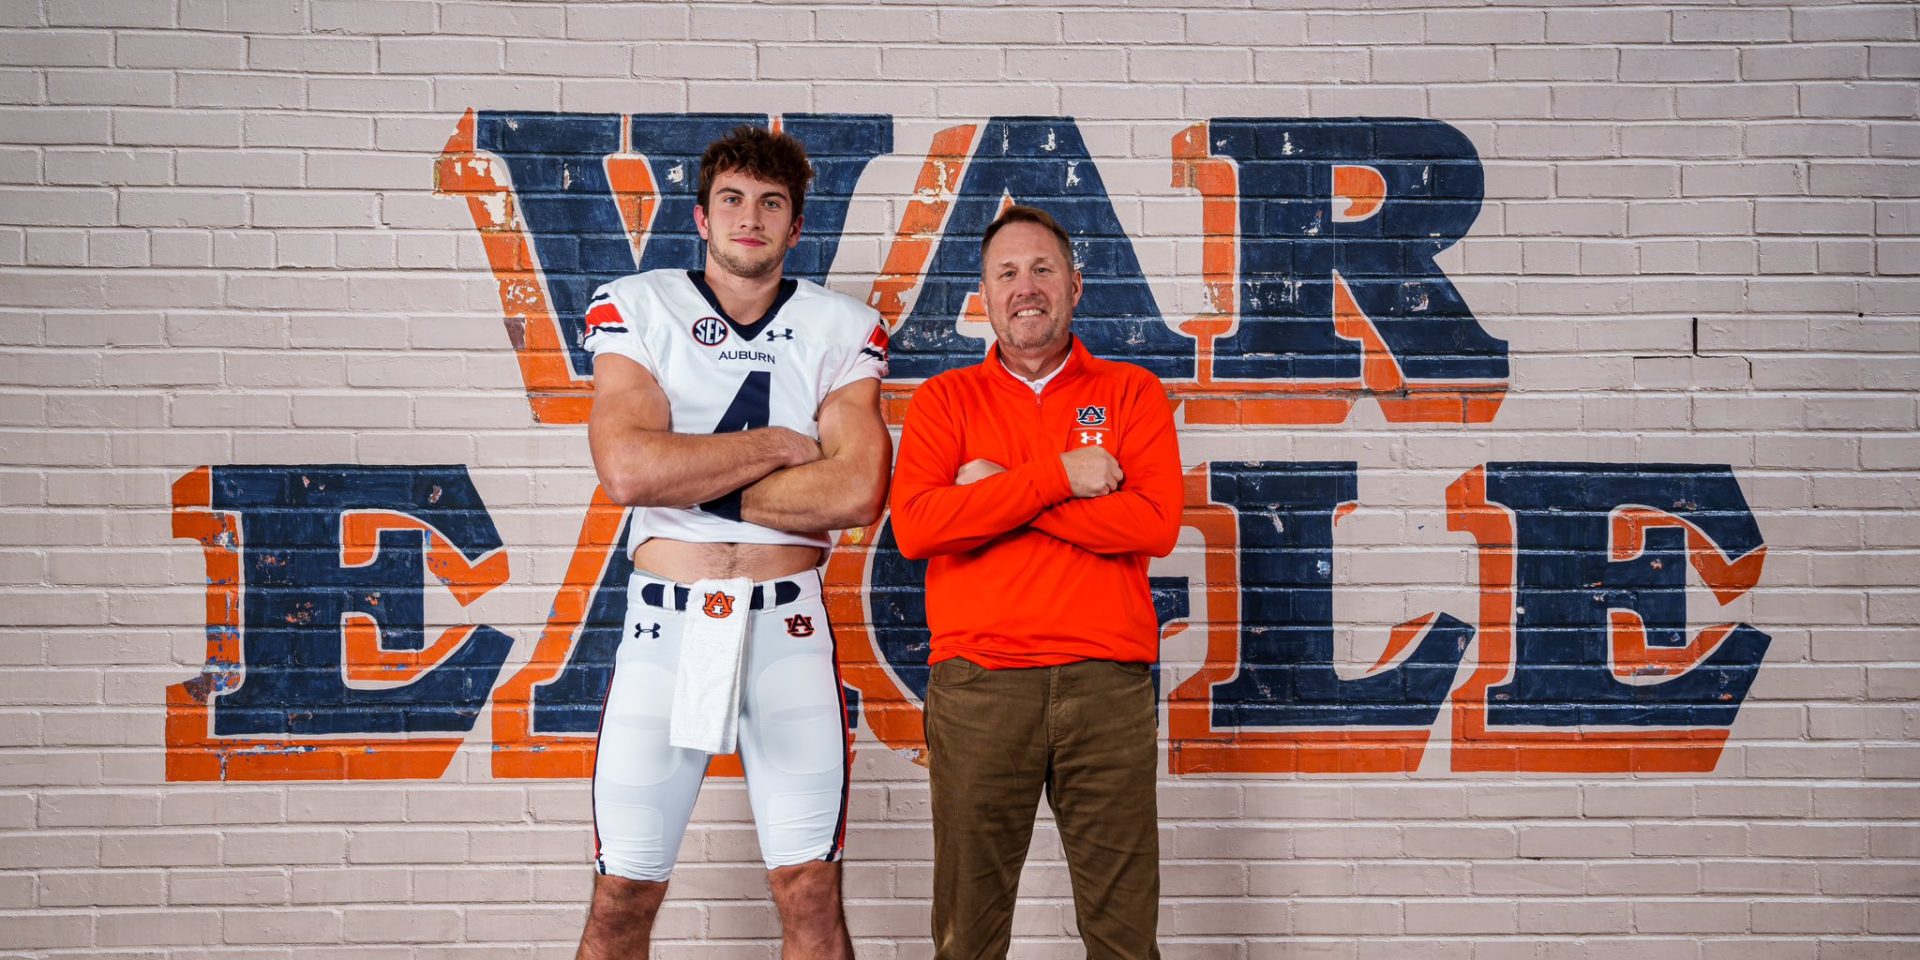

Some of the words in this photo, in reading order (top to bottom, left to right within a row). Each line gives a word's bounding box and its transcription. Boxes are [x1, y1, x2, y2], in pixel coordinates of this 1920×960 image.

[695, 319, 727, 345] SEC
[718, 350, 776, 365] AUBURN
[211, 461, 1771, 737] ELE
